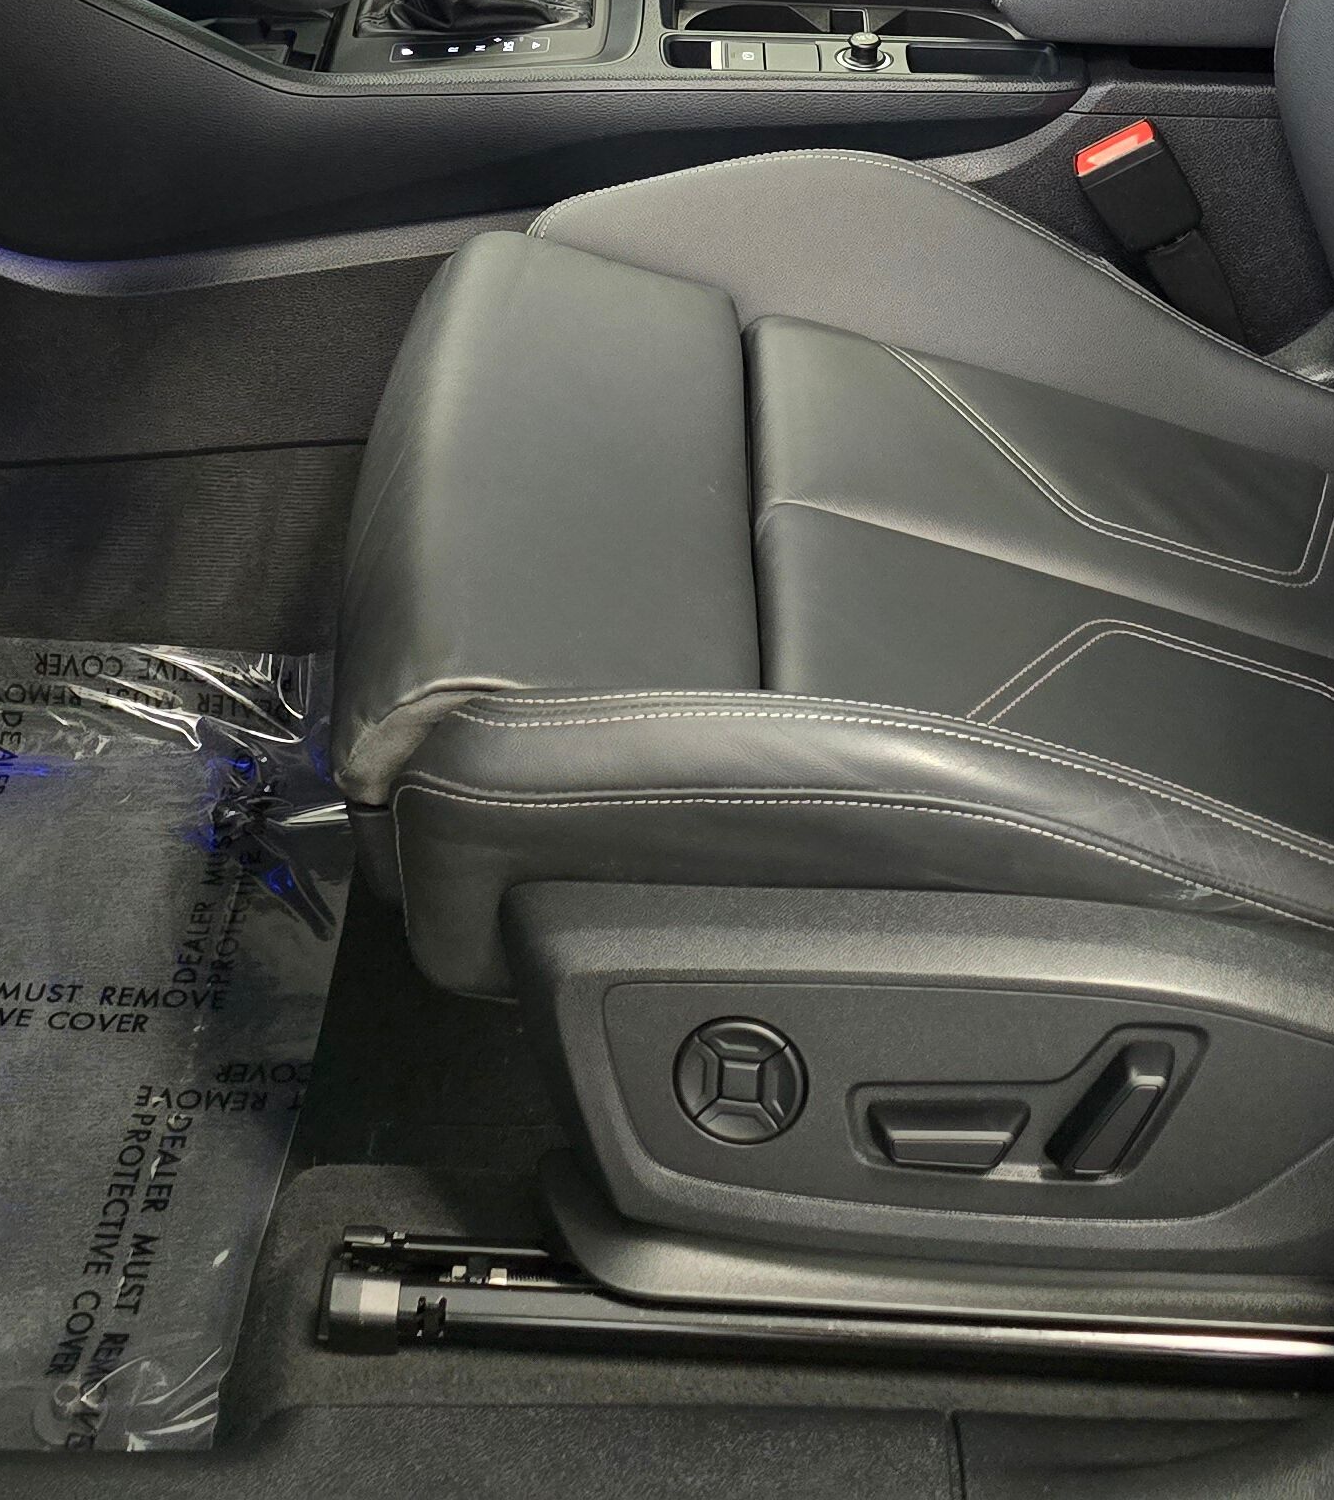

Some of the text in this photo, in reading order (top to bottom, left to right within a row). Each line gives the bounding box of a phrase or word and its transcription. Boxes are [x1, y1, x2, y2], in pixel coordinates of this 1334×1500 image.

[35, 653, 124, 678] COVER
[173, 901, 215, 984] DEALER
[47, 1010, 150, 1033] COVER
[99, 985, 224, 1010] REMOVE
[134, 1085, 268, 1113] REMOVE
[140, 1112, 193, 1214] DEALER
[46, 1112, 157, 1378] PROTECTIVE COVER
[113, 1233, 159, 1315] MUST
